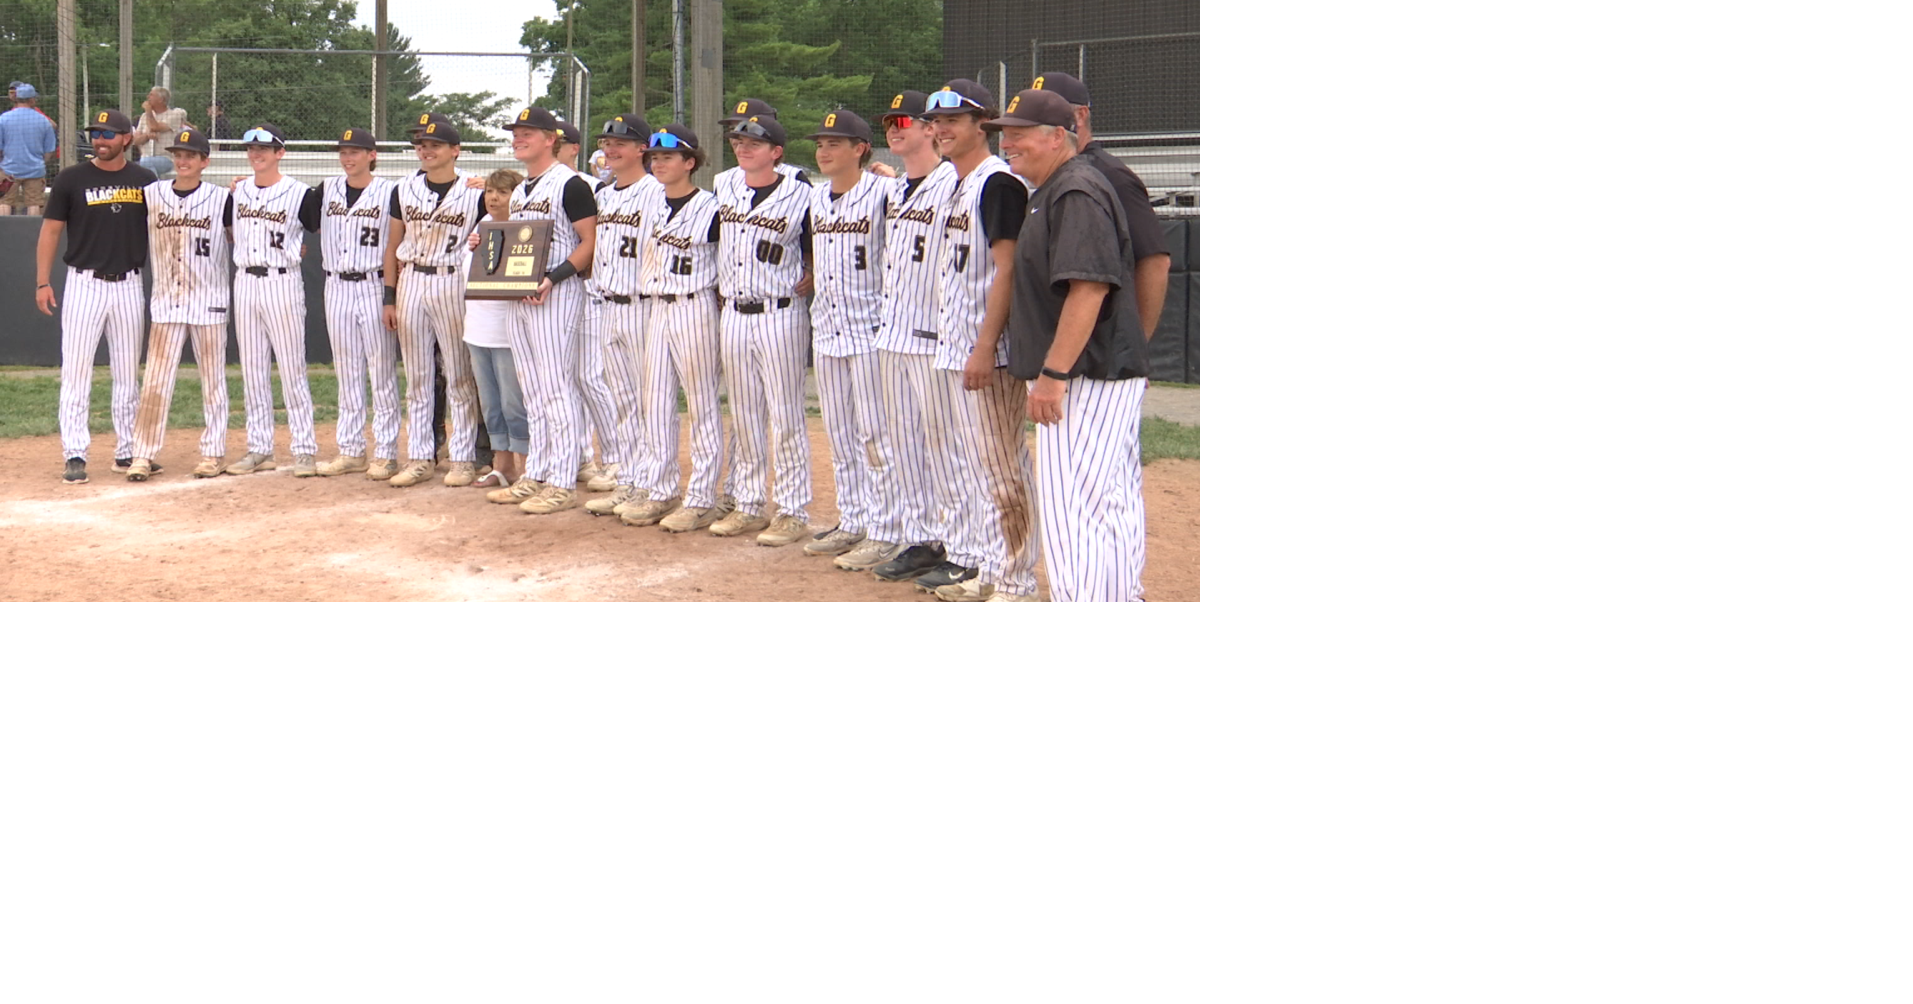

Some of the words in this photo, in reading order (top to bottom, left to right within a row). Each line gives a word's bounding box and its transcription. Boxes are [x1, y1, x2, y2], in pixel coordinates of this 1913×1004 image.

[736, 101, 748, 114] G
[891, 94, 903, 109] G
[1006, 95, 1020, 113] G
[98, 112, 109, 123] G
[420, 113, 429, 125] G
[520, 109, 530, 120] G
[824, 113, 836, 128] G
[180, 131, 190, 142] G
[343, 129, 353, 141] G
[426, 123, 436, 134] G
[85, 188, 143, 203] BLACKCATS
[156, 212, 211, 231] Blackcats
[236, 203, 287, 224] Blackcats
[269, 230, 285, 250] 12
[360, 226, 380, 247] 23
[445, 235, 458, 254] 2
[195, 237, 210, 257] 15
[511, 244, 534, 254] 2026
[619, 235, 637, 259] 21
[756, 238, 784, 266] 00
[912, 234, 926, 263] 5
[670, 254, 692, 275] 16
[854, 245, 866, 270] 3
